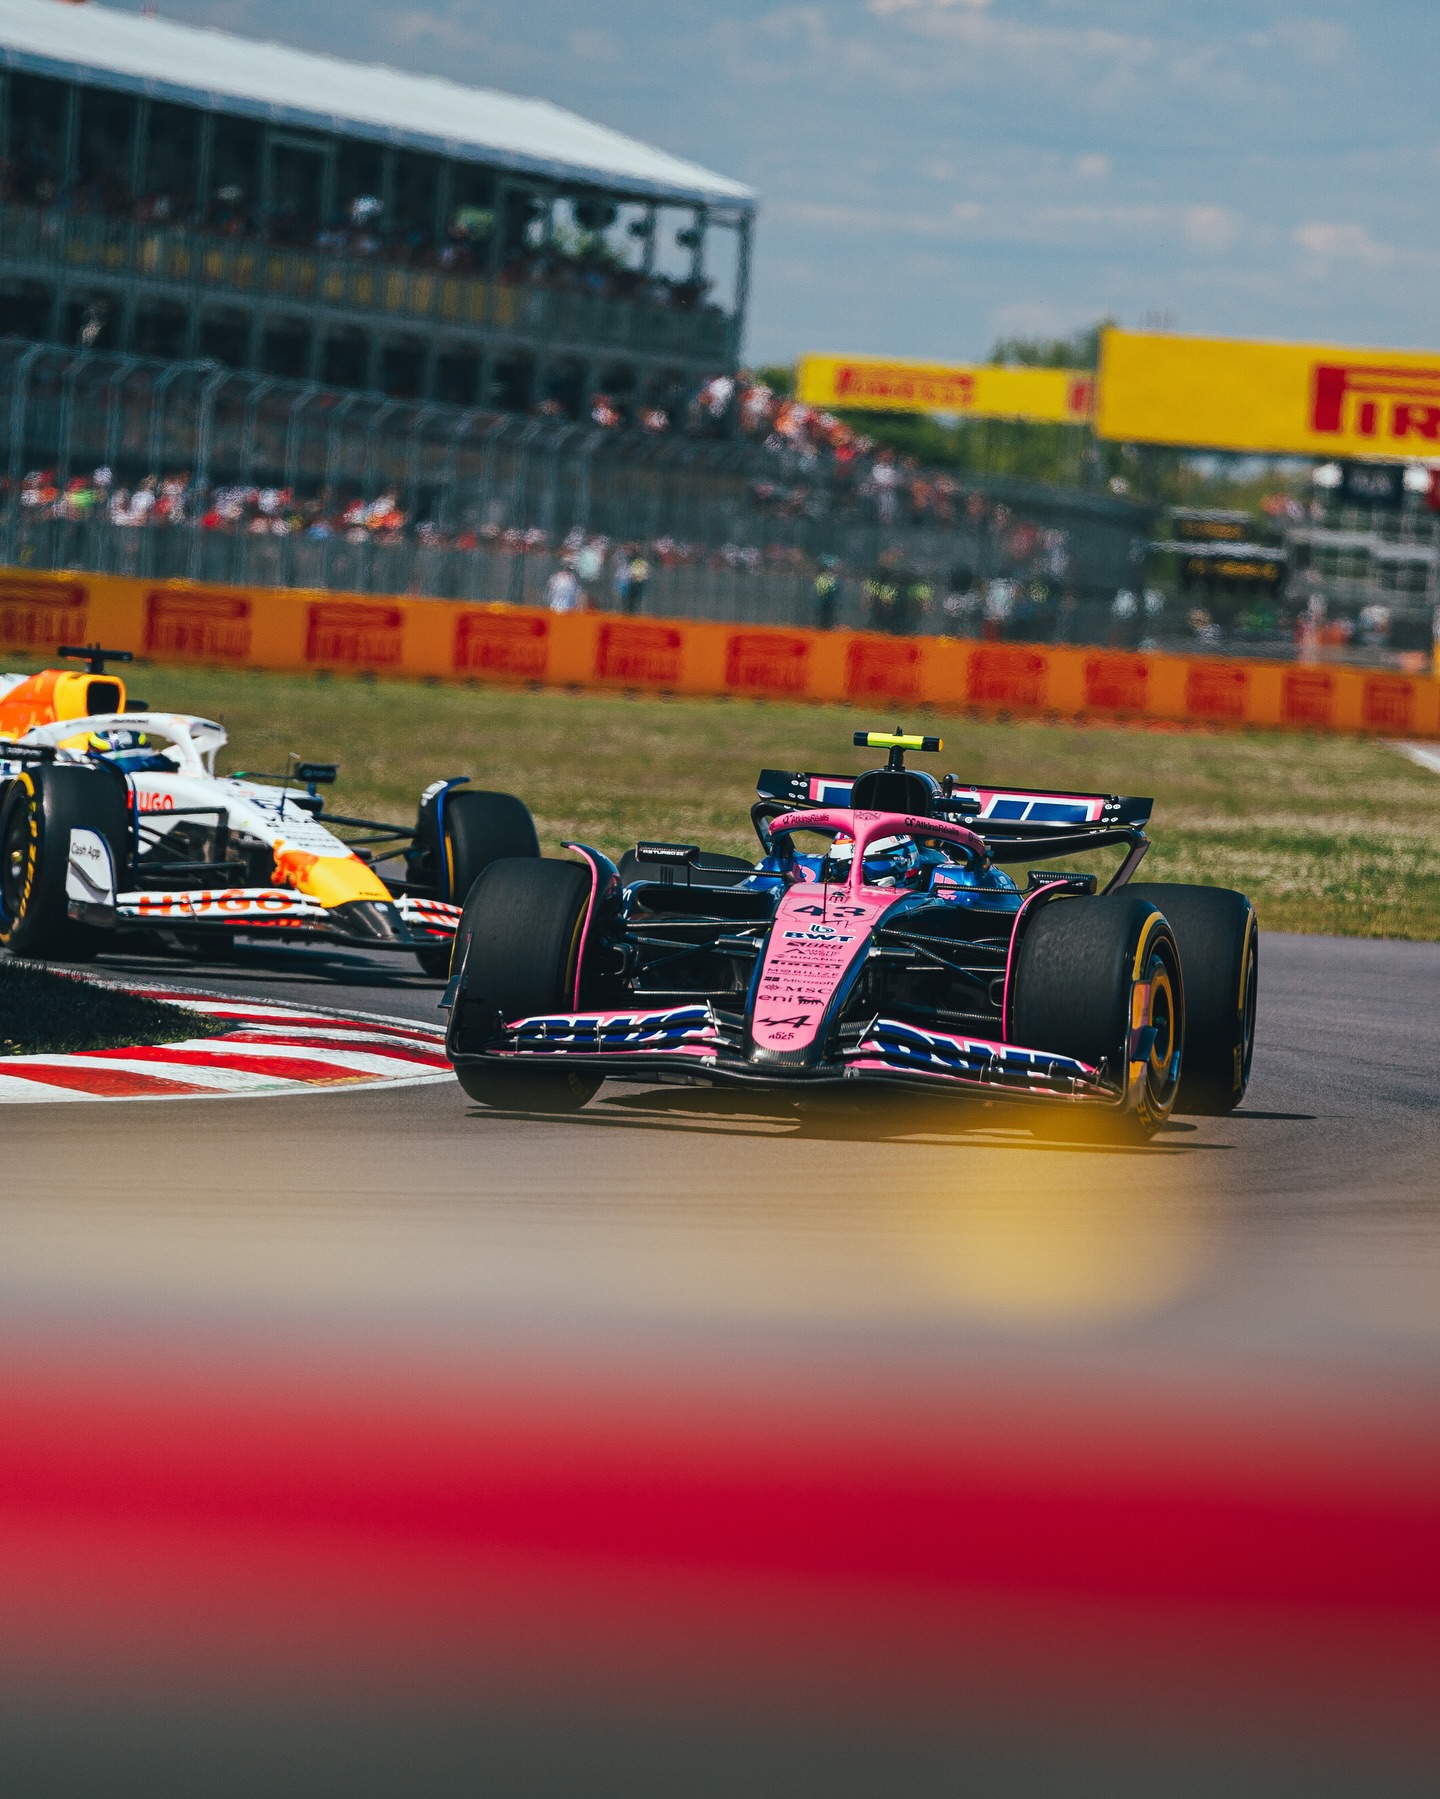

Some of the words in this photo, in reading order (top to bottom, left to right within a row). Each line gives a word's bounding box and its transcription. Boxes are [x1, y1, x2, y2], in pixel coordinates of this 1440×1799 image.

[71, 842, 86, 855] Cash
[88, 845, 100, 860] App
[138, 889, 293, 916] HUGO
[793, 905, 866, 917] 43
[784, 931, 854, 942] BWT
[785, 986, 832, 994] MSC
[758, 995, 793, 1003] eni
[768, 1031, 795, 1040] A525
